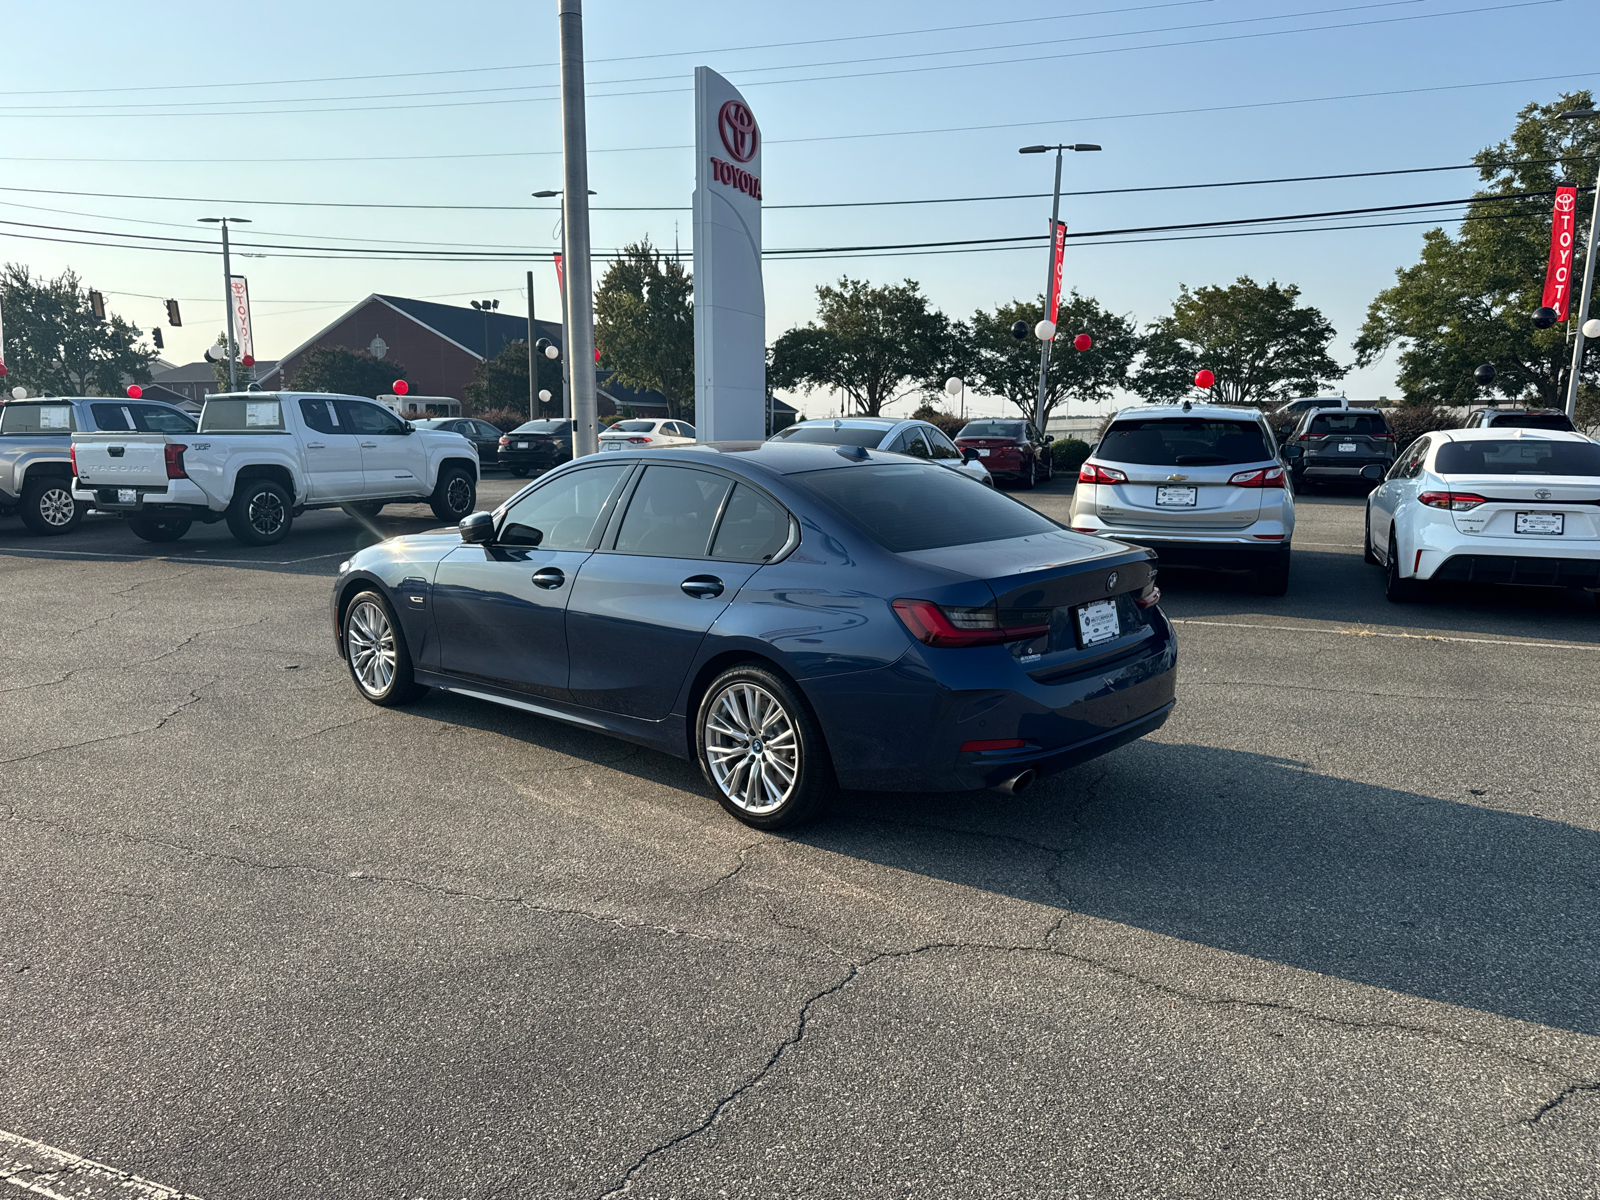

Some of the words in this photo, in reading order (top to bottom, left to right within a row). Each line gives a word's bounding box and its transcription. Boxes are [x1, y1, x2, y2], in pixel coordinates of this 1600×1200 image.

[710, 156, 762, 201] TOYOTA
[1552, 215, 1571, 316] TOYOTA
[235, 295, 248, 355] TOYO
[89, 464, 152, 473] TACOMA
